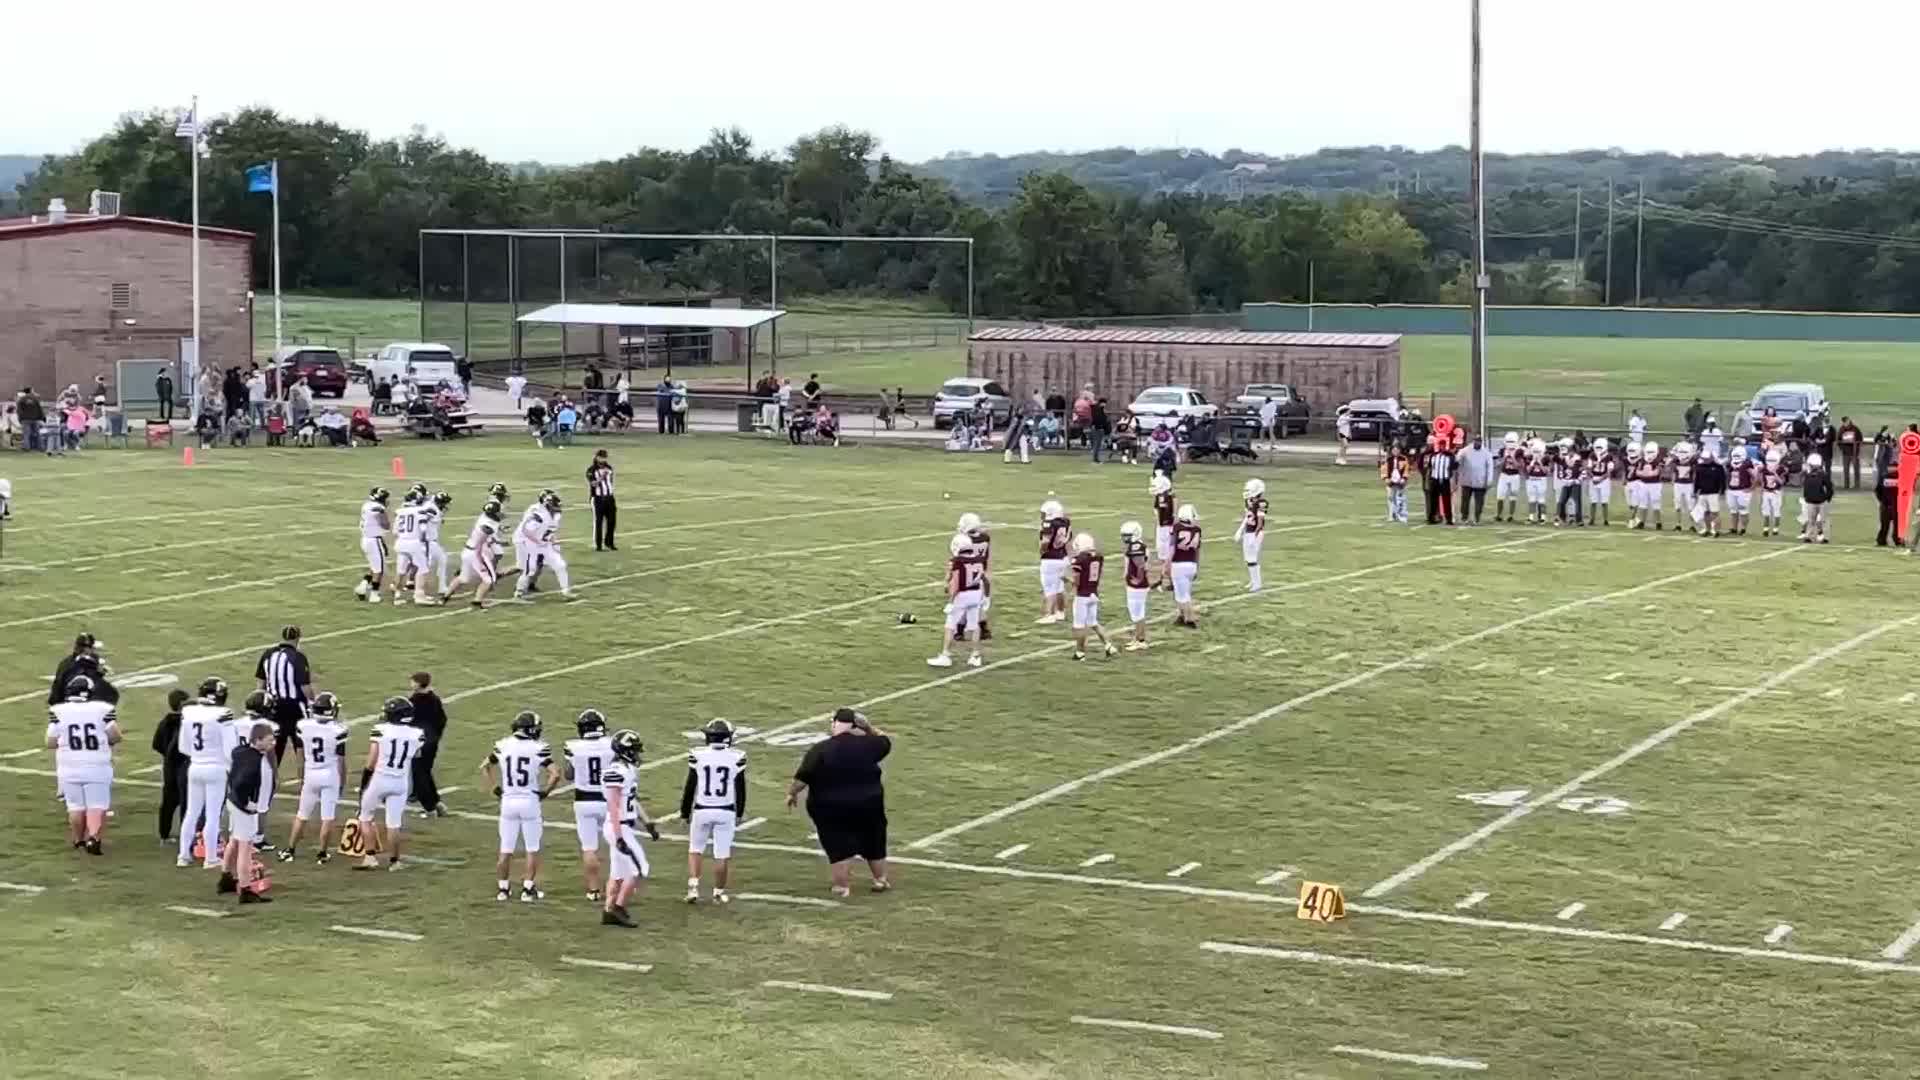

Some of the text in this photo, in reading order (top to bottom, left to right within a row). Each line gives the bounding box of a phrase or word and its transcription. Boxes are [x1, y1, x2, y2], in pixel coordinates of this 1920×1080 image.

[398, 515, 414, 532] 20
[1178, 530, 1200, 549] 24
[68, 723, 99, 750] 66
[192, 722, 204, 751] 3
[312, 737, 325, 763] 2
[386, 740, 410, 769] 11
[504, 755, 530, 787] 15
[704, 766, 730, 796] 13
[1303, 886, 1336, 920] 40
